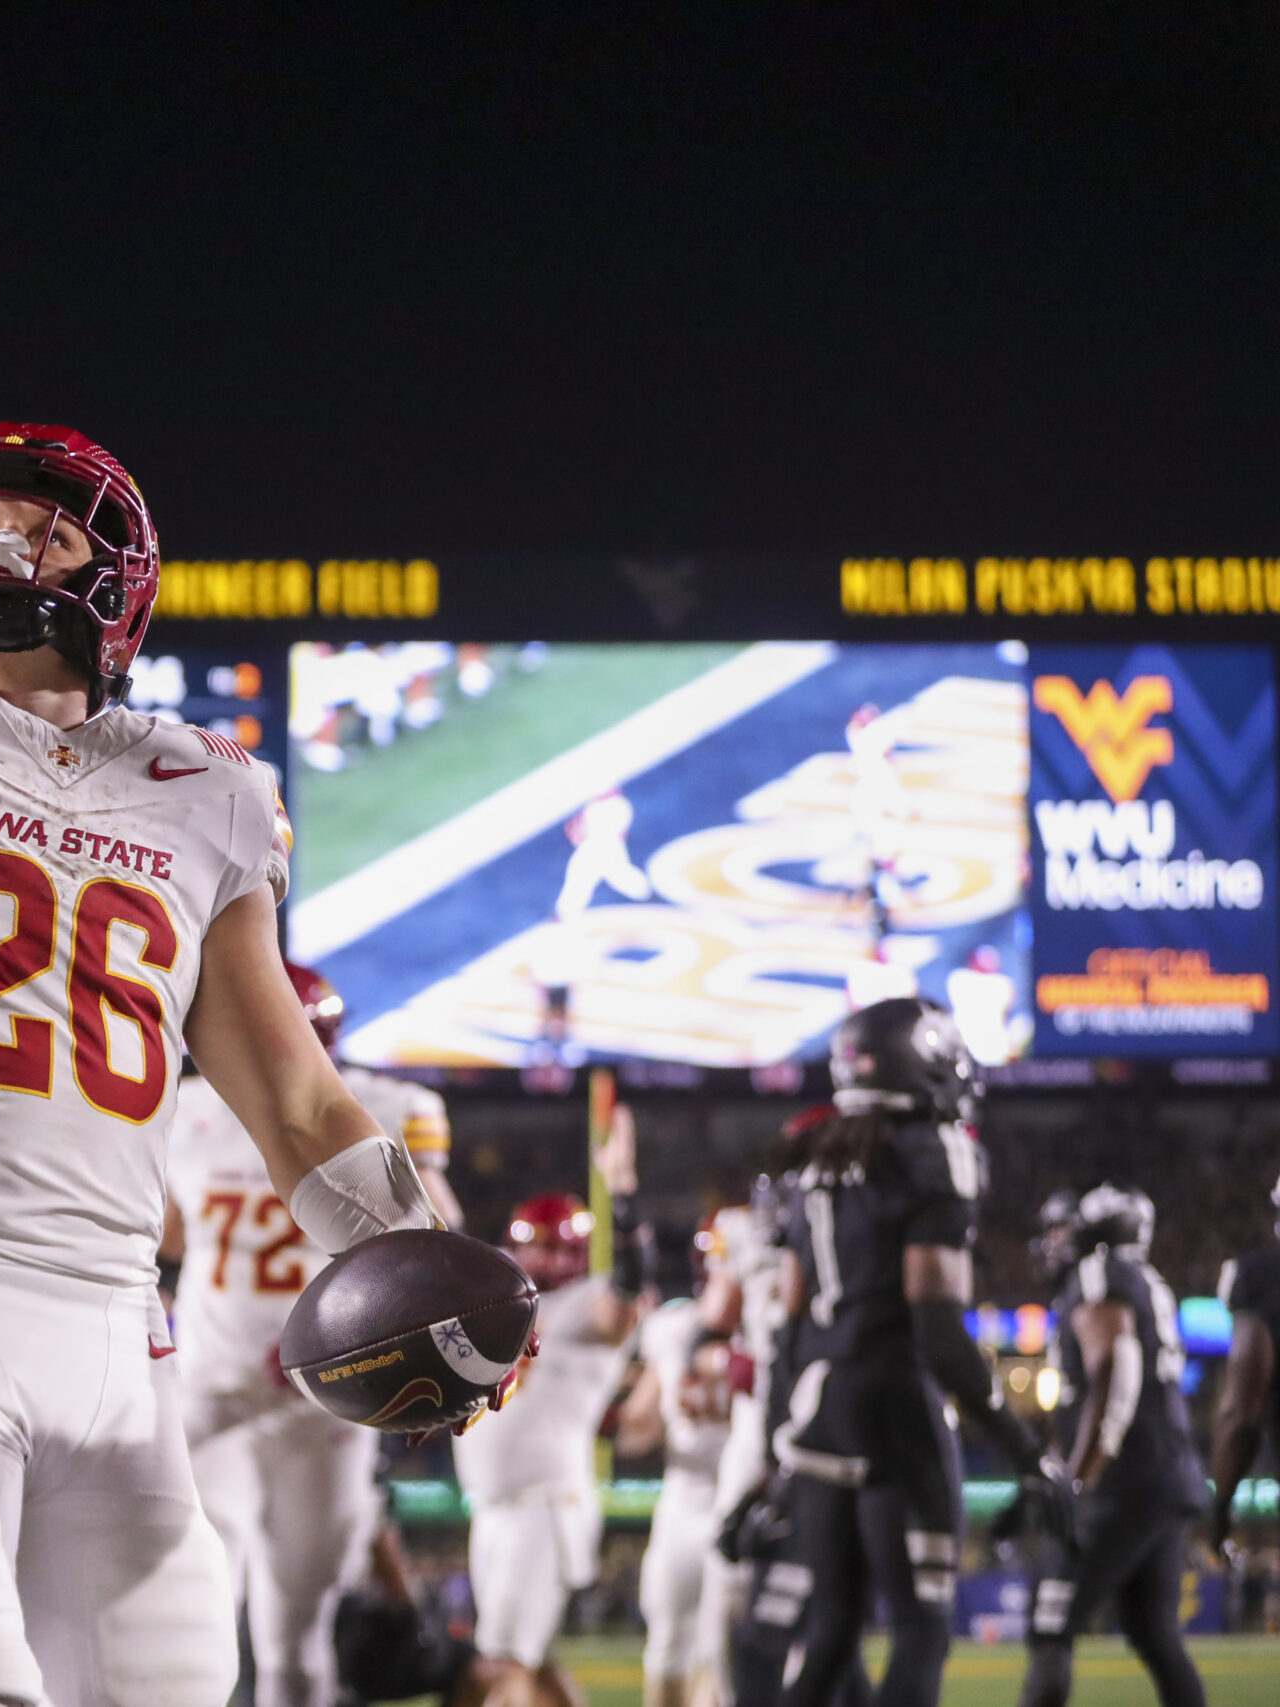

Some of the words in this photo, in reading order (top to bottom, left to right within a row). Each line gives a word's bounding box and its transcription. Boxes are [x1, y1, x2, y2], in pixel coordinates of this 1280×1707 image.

[318, 559, 438, 617] FIELD
[841, 558, 968, 616] MILAN
[975, 557, 1137, 616] PUSKAR
[59, 827, 173, 880] STATE
[1035, 799, 1176, 858] WVU
[1045, 849, 1264, 910] Medicine
[201, 1192, 305, 1293] 72
[317, 1364, 355, 1384] ELITE
[351, 1350, 405, 1374] VAPOR
